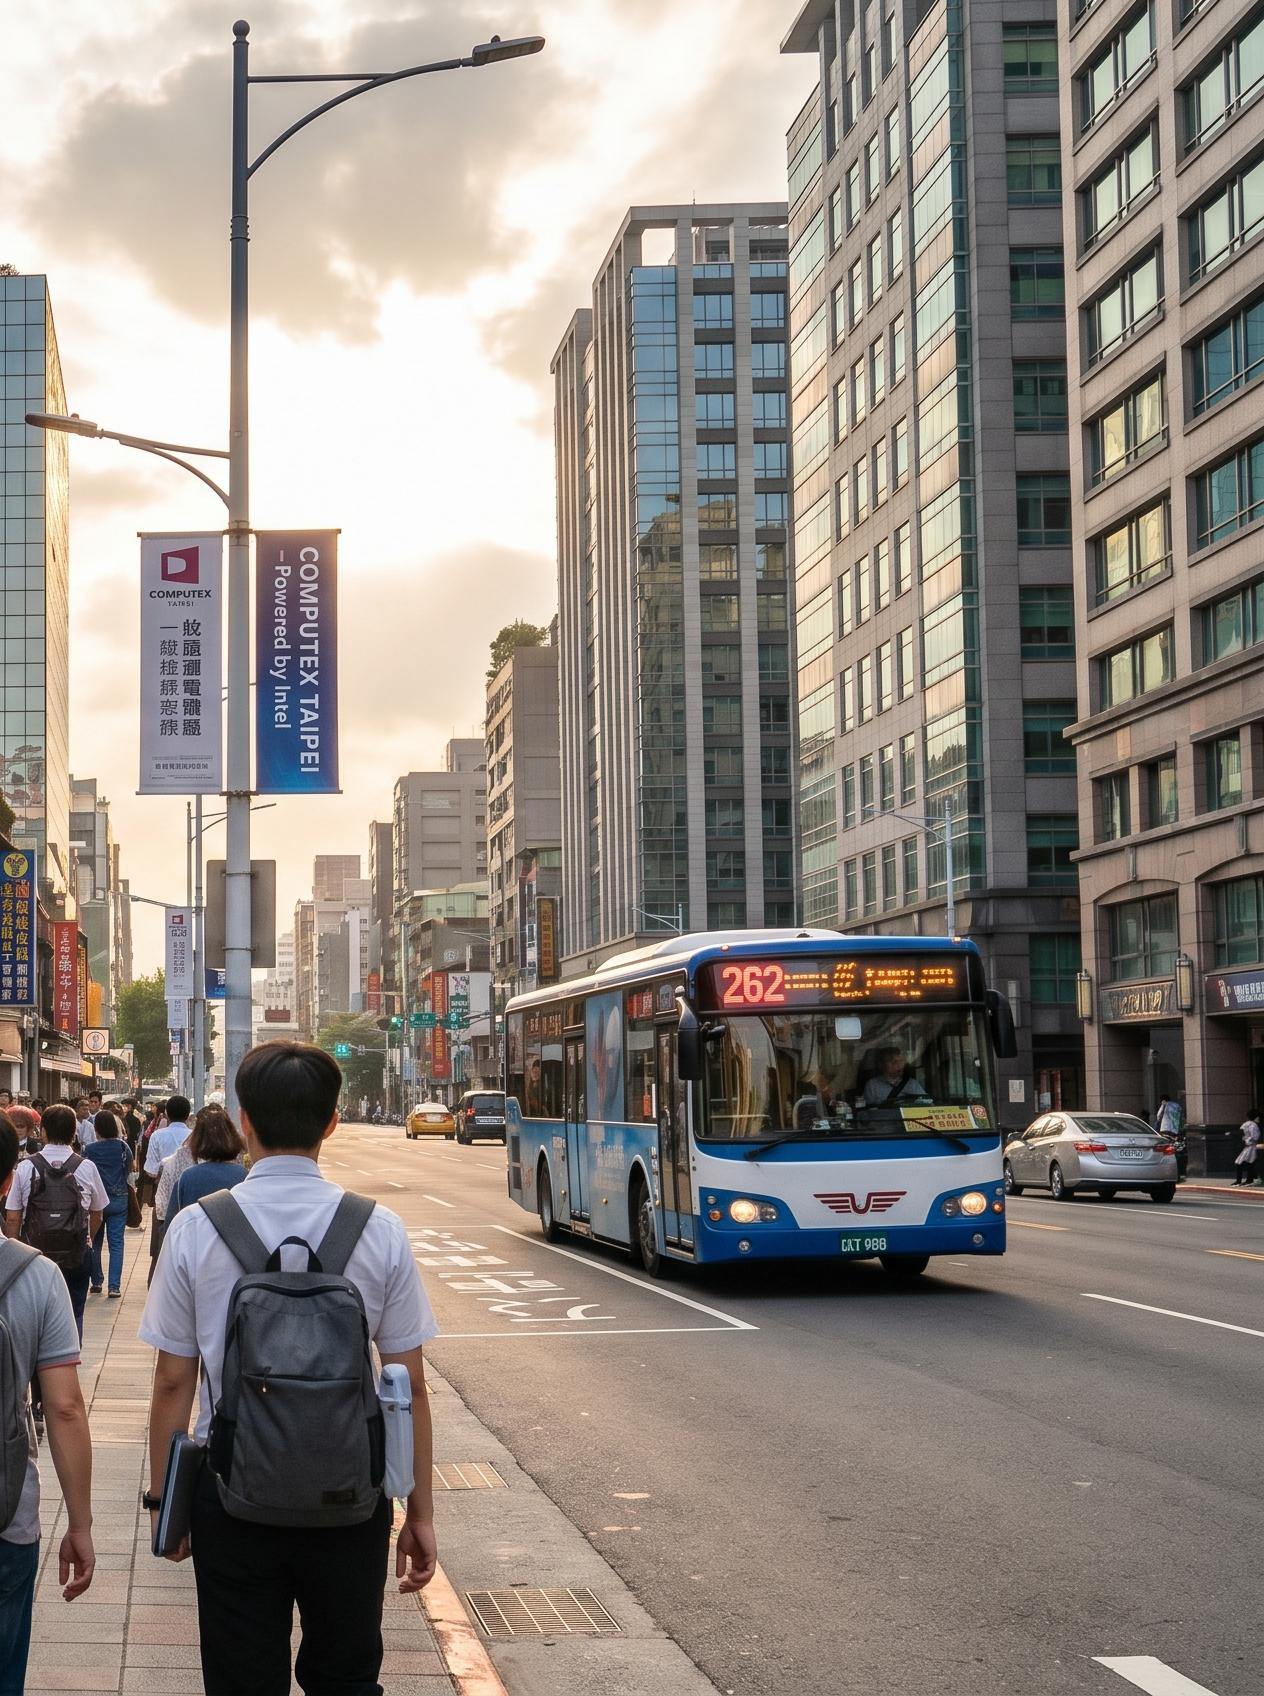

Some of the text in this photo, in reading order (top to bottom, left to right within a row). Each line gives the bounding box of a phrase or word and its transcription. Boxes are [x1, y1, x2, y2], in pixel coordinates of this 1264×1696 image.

[149, 590, 212, 599] COMPUTEX
[274, 565, 291, 649] Powered
[269, 655, 291, 680] by
[299, 546, 320, 772] COMPUTEX TAIPEI
[274, 685, 291, 728] Intel
[722, 965, 785, 1004] 262
[864, 1237, 887, 1251] 988
